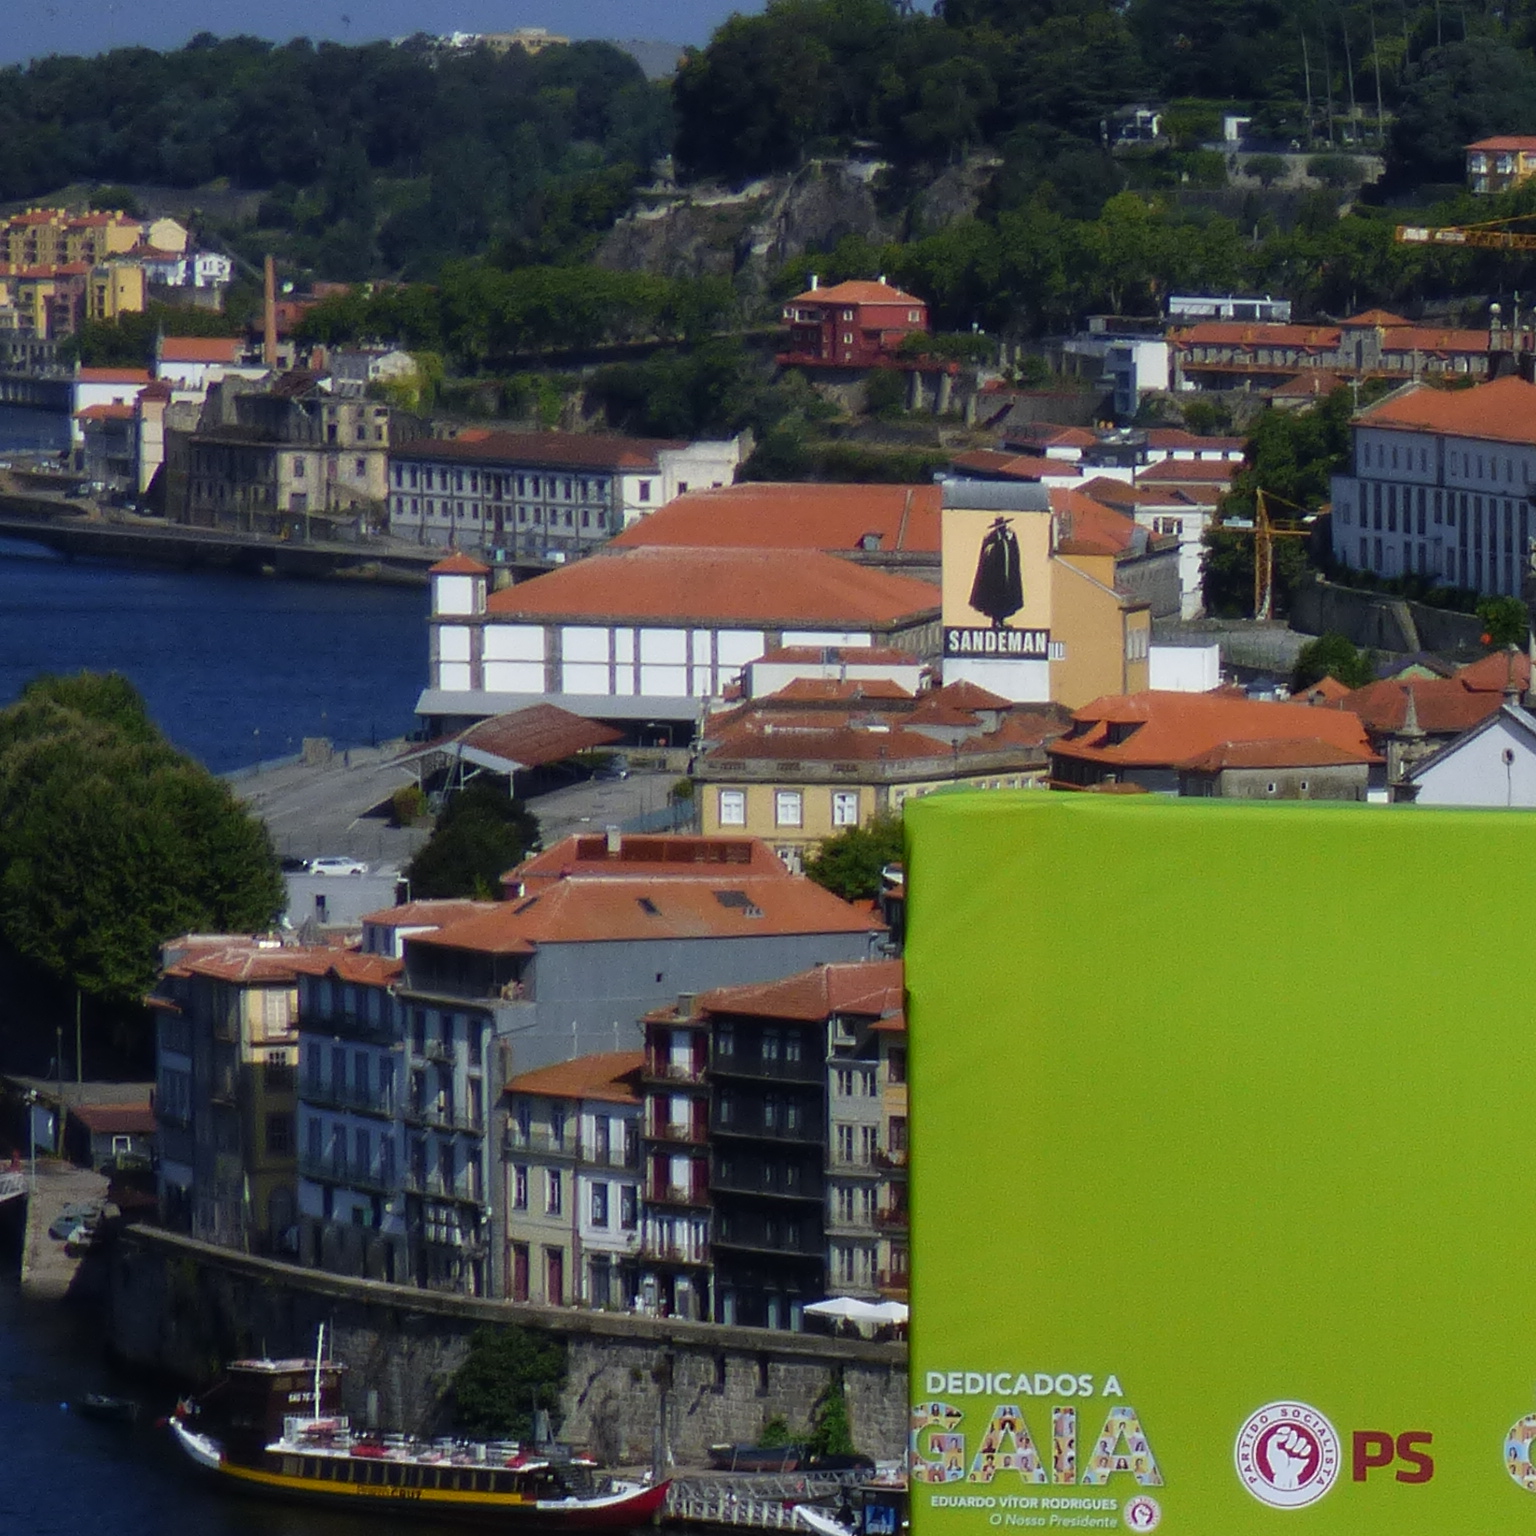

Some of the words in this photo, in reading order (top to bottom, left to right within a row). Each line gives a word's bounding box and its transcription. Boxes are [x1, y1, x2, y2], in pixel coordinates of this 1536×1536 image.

[949, 630, 1046, 652] SANDEMAN
[926, 1371, 1094, 1397] DEDICADOS
[1102, 1374, 1123, 1397] A
[910, 1401, 1164, 1487] GAIA
[1241, 1414, 1268, 1484] PARTIDO
[1281, 1408, 1334, 1486] SOCIALISTA
[1353, 1431, 1434, 1483] PS
[931, 1495, 996, 1509] EDUARDO
[1000, 1493, 1038, 1510] VÍTOR
[1041, 1498, 1118, 1511] RODRIGUES
[990, 1513, 1002, 1526] O
[1006, 1513, 1046, 1527] Nosso
[1050, 1515, 1118, 1528] Presidente
